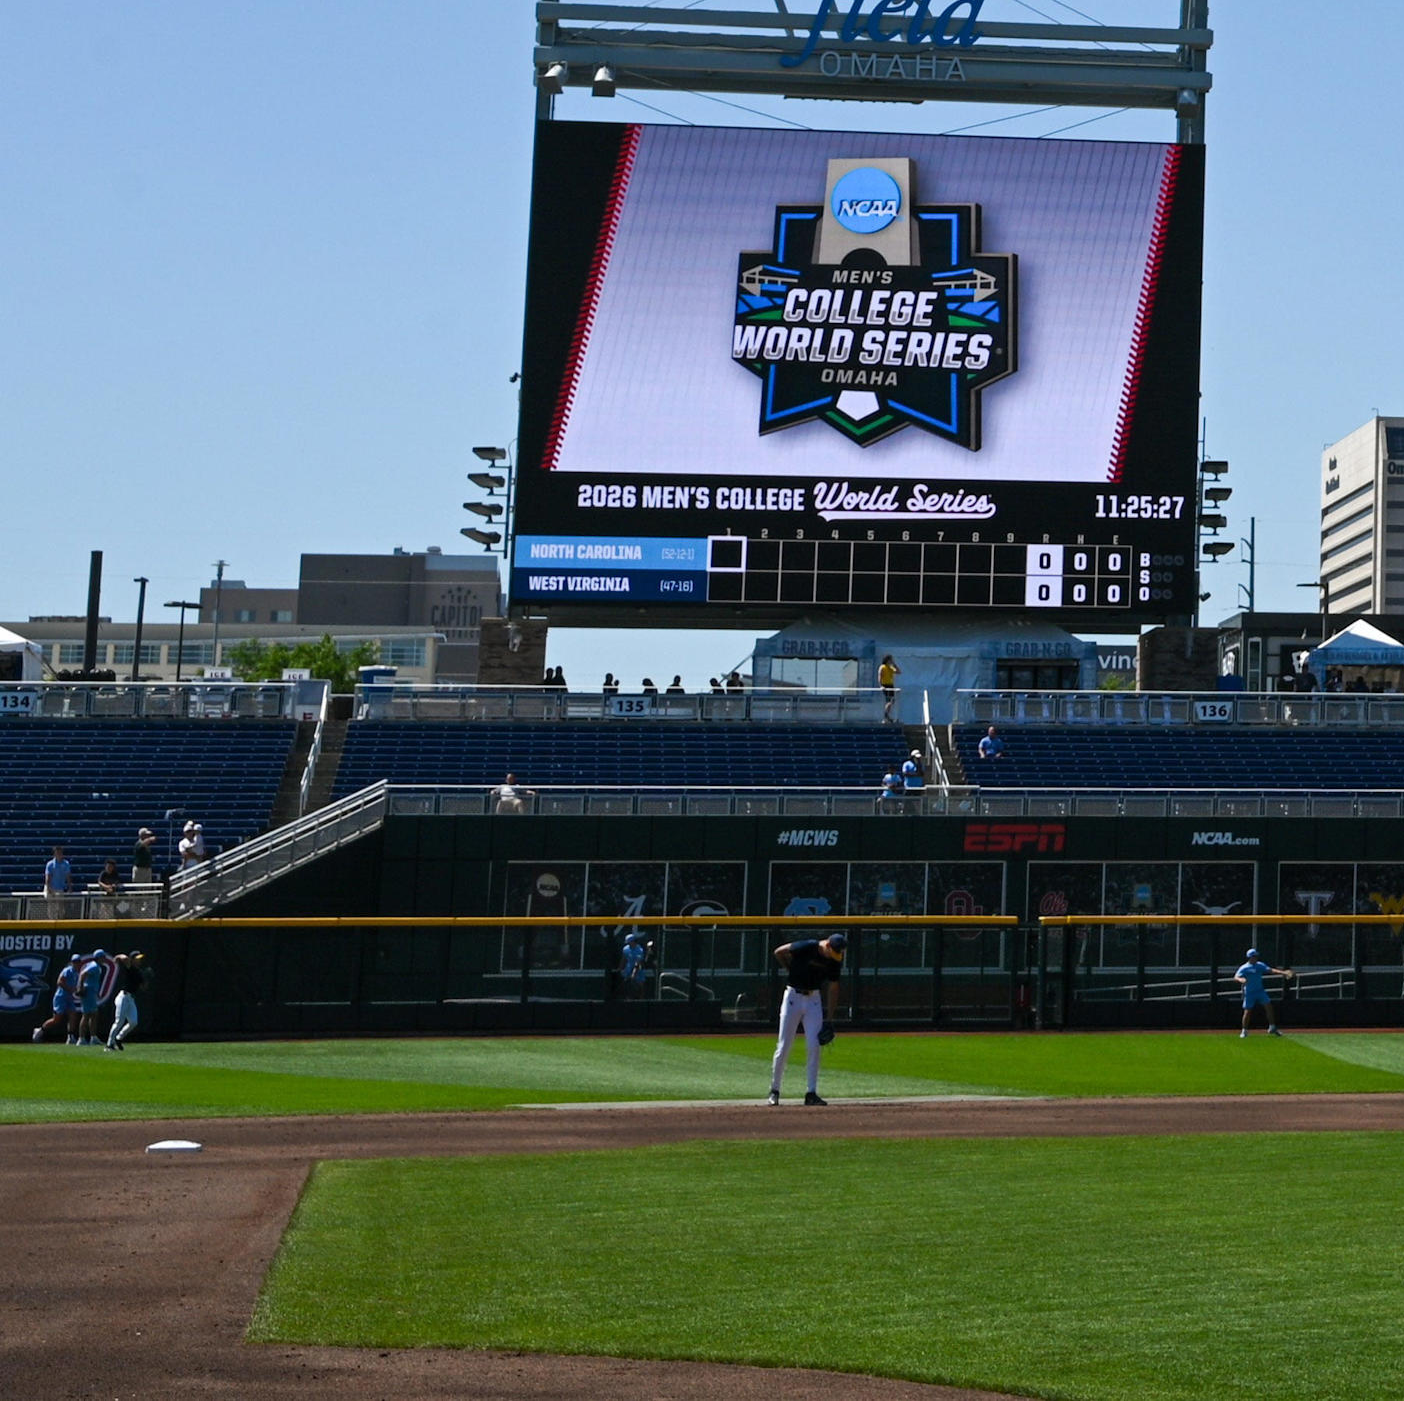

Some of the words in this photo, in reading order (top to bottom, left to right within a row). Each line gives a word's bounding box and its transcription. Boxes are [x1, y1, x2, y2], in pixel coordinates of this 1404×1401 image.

[819, 51, 967, 81] OMAHA
[838, 200, 900, 217] NCAA
[832, 270, 893, 284] MEN'S
[783, 288, 938, 327] COLLEGE
[733, 324, 855, 365] WORLD
[858, 329, 994, 370] SERIES
[821, 368, 898, 387] OMAHA
[577, 484, 637, 508] 2026
[641, 485, 709, 509] MEN'S
[715, 487, 806, 511] COLLEGE
[813, 481, 900, 513] World
[906, 484, 996, 515] Series
[1094, 494, 1185, 519] 11:25:27
[760, 528, 769, 539] 2
[796, 529, 804, 540] 3
[831, 529, 839, 540] 4
[867, 530, 875, 541] 5
[902, 531, 910, 542] 6
[937, 531, 945, 542] 7
[1007, 532, 1015, 543] 9
[1113, 535, 1119, 545] E
[530, 543, 576, 559] NORTH
[576, 544, 642, 560] CAROLINA
[1139, 552, 1150, 567] B
[1039, 552, 1051, 569] 0
[1073, 552, 1087, 570] 0
[1108, 553, 1122, 571] 0
[529, 575, 567, 591] WEST
[567, 577, 630, 592] VIRGINIA
[1139, 570, 1150, 584] S
[1038, 584, 1050, 601] 0
[1073, 584, 1086, 602] 0
[1107, 585, 1120, 603] 0
[1, 695, 30, 709] 134
[616, 699, 644, 715] 135
[1201, 704, 1228, 719] 136
[776, 829, 839, 847] #MCWS
[963, 824, 1066, 852] ESPN
[1191, 831, 1260, 846] NCAA.com
[55, 935, 75, 950] BY
